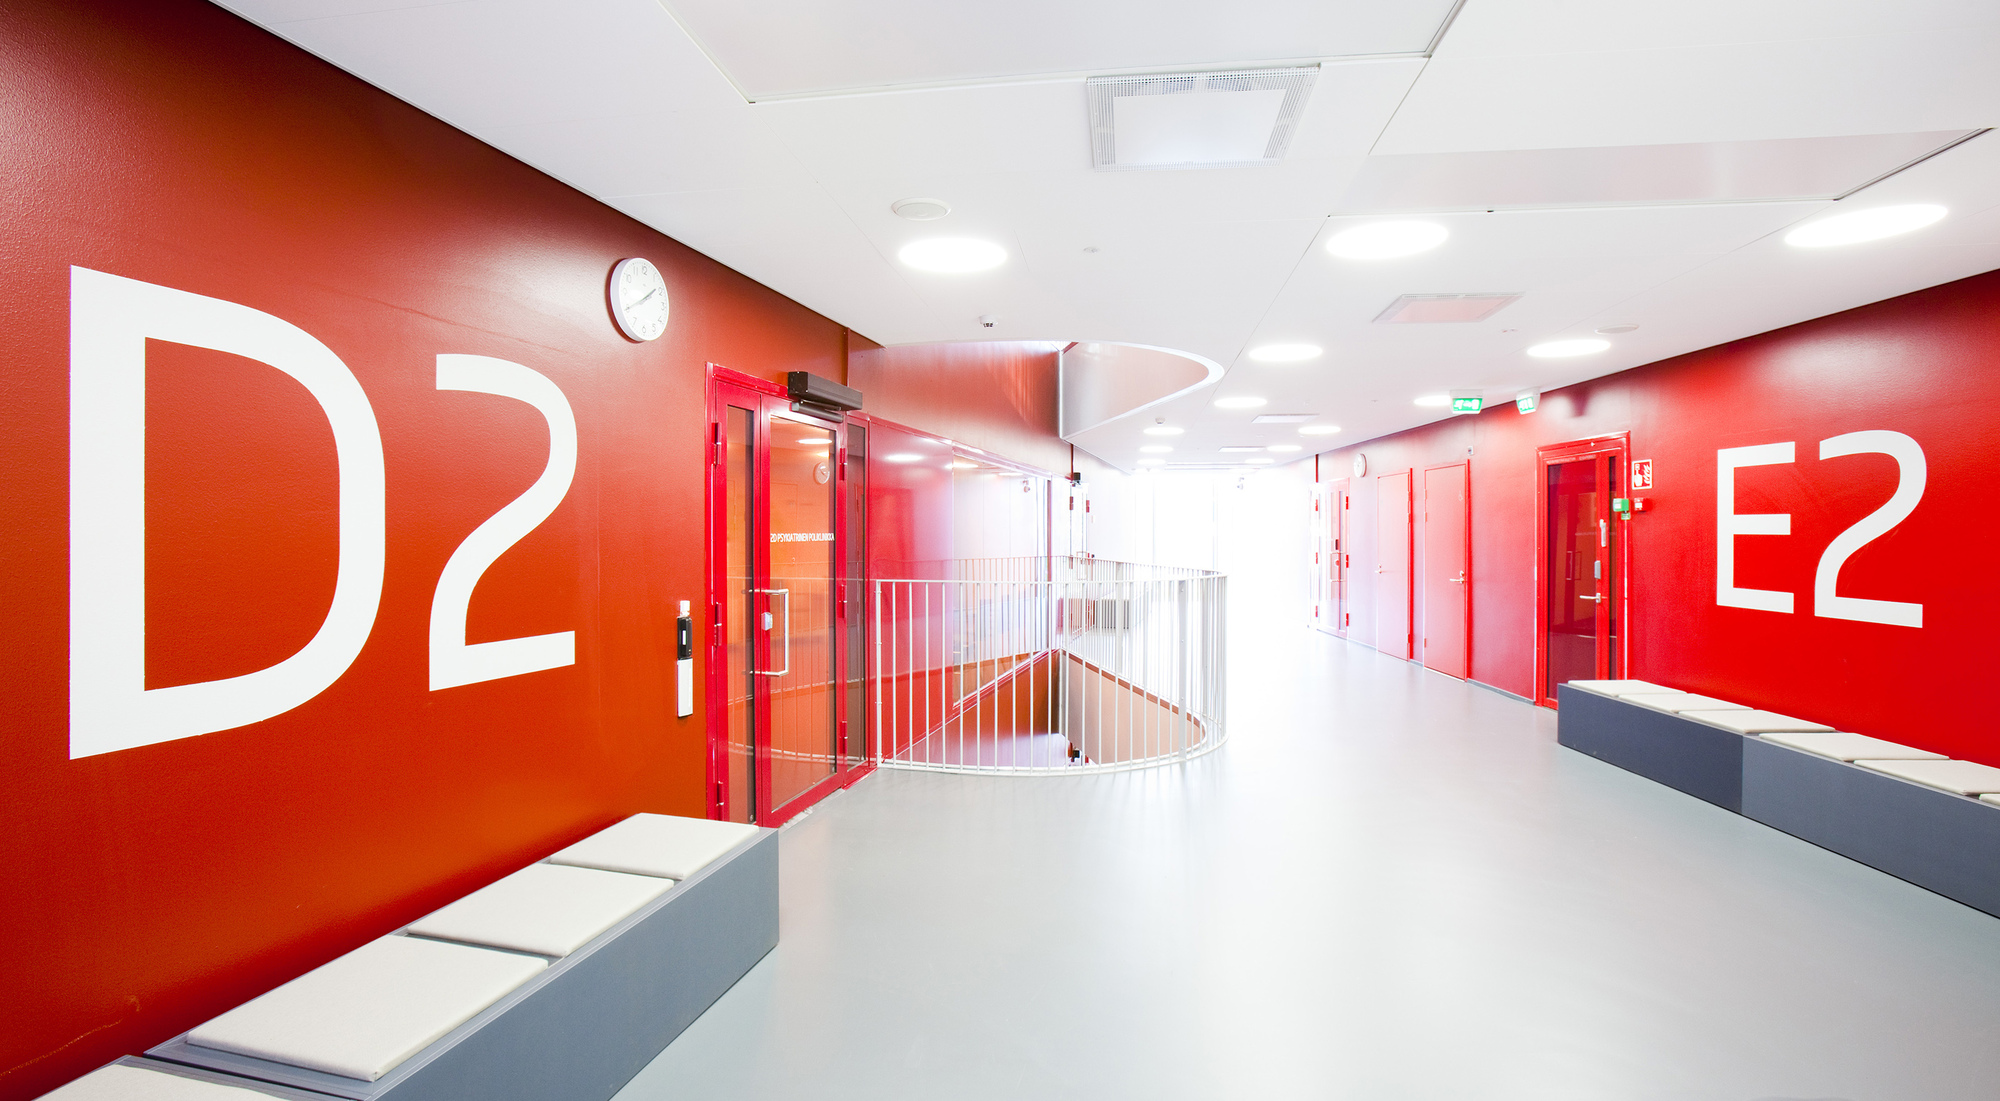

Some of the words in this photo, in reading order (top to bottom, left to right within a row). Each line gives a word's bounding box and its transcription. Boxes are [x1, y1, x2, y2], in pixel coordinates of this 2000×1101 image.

[69, 265, 579, 760] D2
[770, 533, 777, 542] 2D
[1716, 429, 1927, 629] E2
